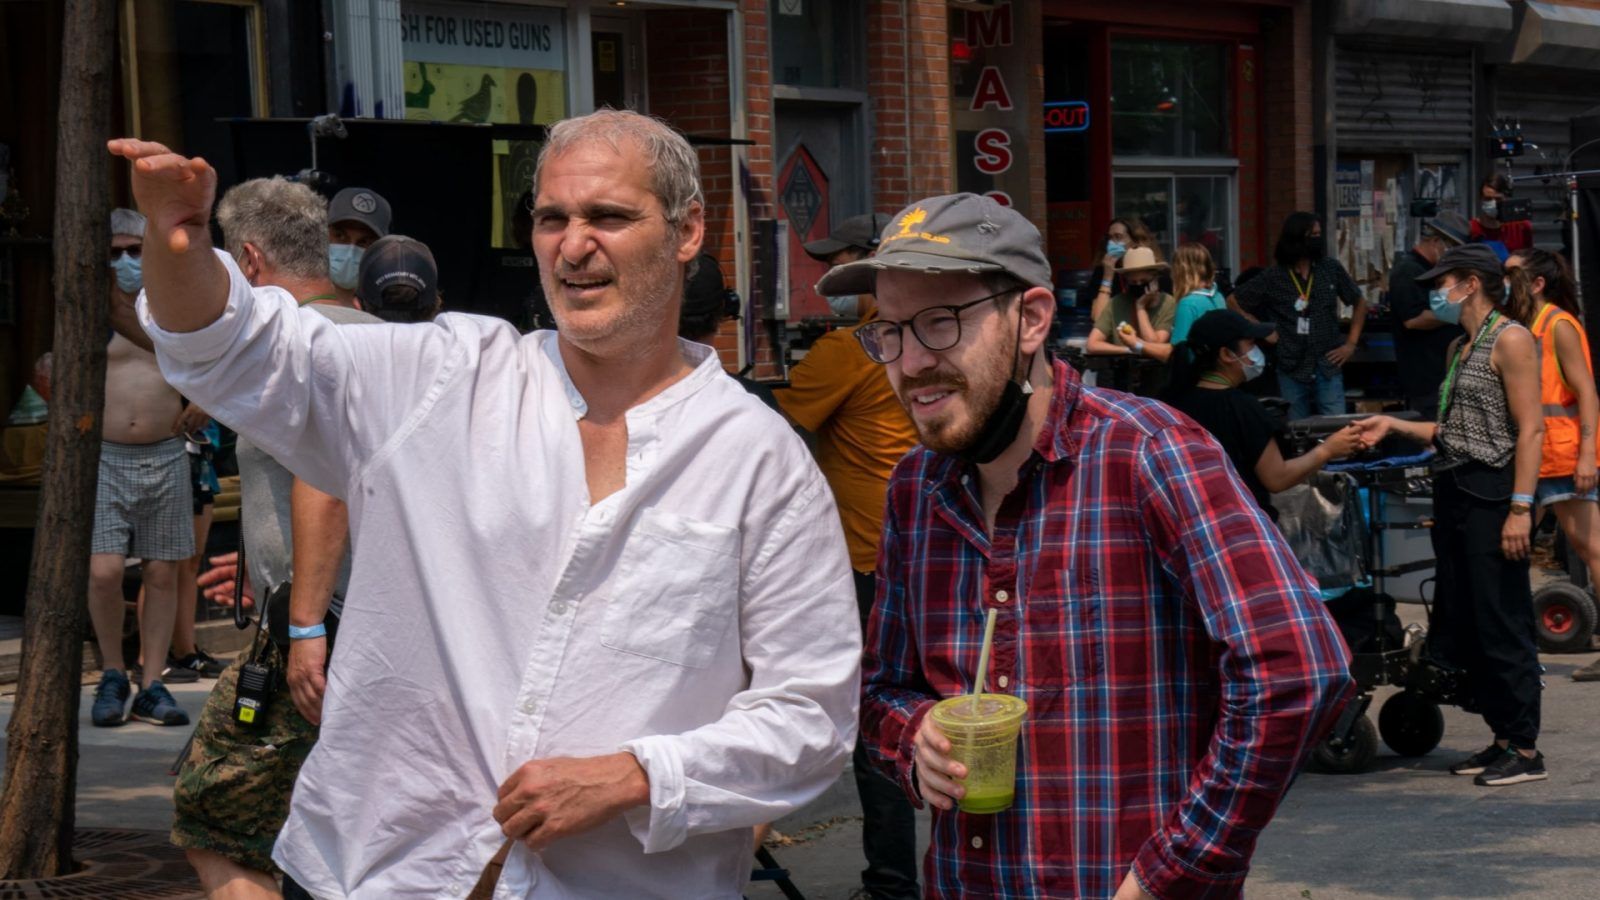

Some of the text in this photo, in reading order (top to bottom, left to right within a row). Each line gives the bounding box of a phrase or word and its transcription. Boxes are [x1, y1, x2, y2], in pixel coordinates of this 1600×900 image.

[426, 16, 458, 46] FOR
[463, 18, 505, 49] USED
[509, 23, 551, 52] GUNS
[965, 1, 1014, 208] MAS
